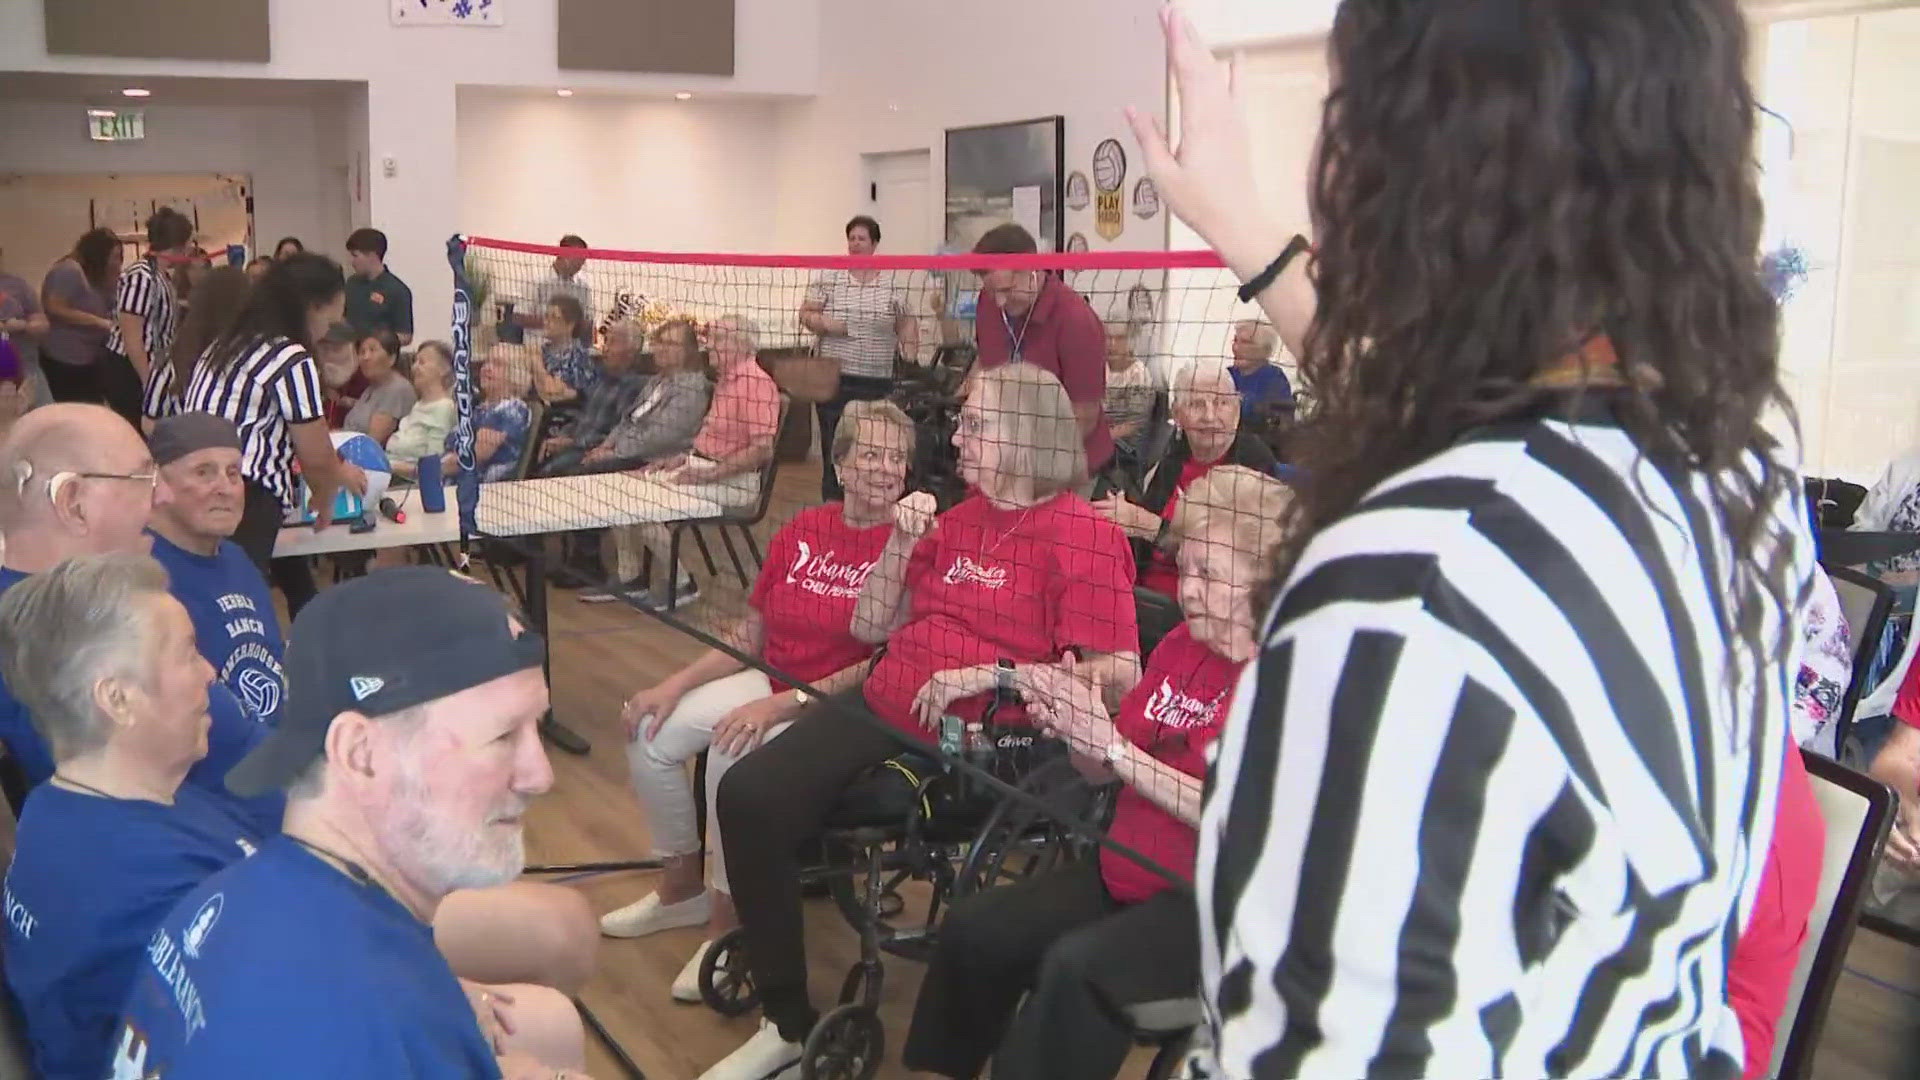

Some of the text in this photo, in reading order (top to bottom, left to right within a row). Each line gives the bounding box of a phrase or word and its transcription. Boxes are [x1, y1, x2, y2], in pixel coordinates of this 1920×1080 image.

[100, 114, 136, 138] EXIT
[1098, 195, 1120, 210] PLAY
[225, 617, 265, 638] RANCH
[998, 735, 1033, 748] drive
